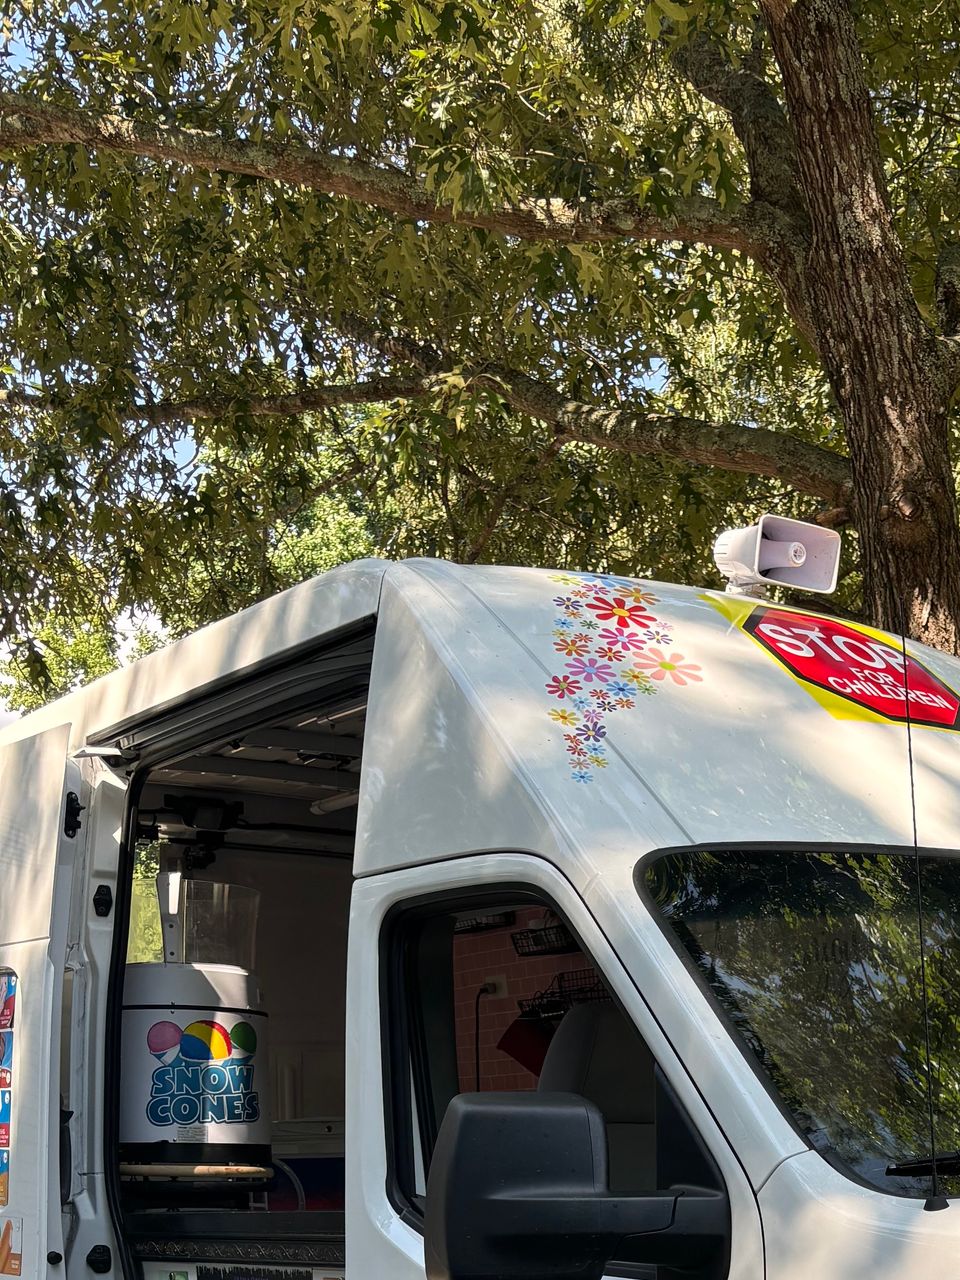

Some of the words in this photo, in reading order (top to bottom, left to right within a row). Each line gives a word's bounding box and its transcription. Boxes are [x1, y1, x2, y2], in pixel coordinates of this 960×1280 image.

[759, 623, 909, 674] STOP
[828, 676, 955, 711] CHILDREN
[851, 668, 900, 688] FOR
[151, 1064, 254, 1096] SNOW
[146, 1092, 260, 1126] CONES
